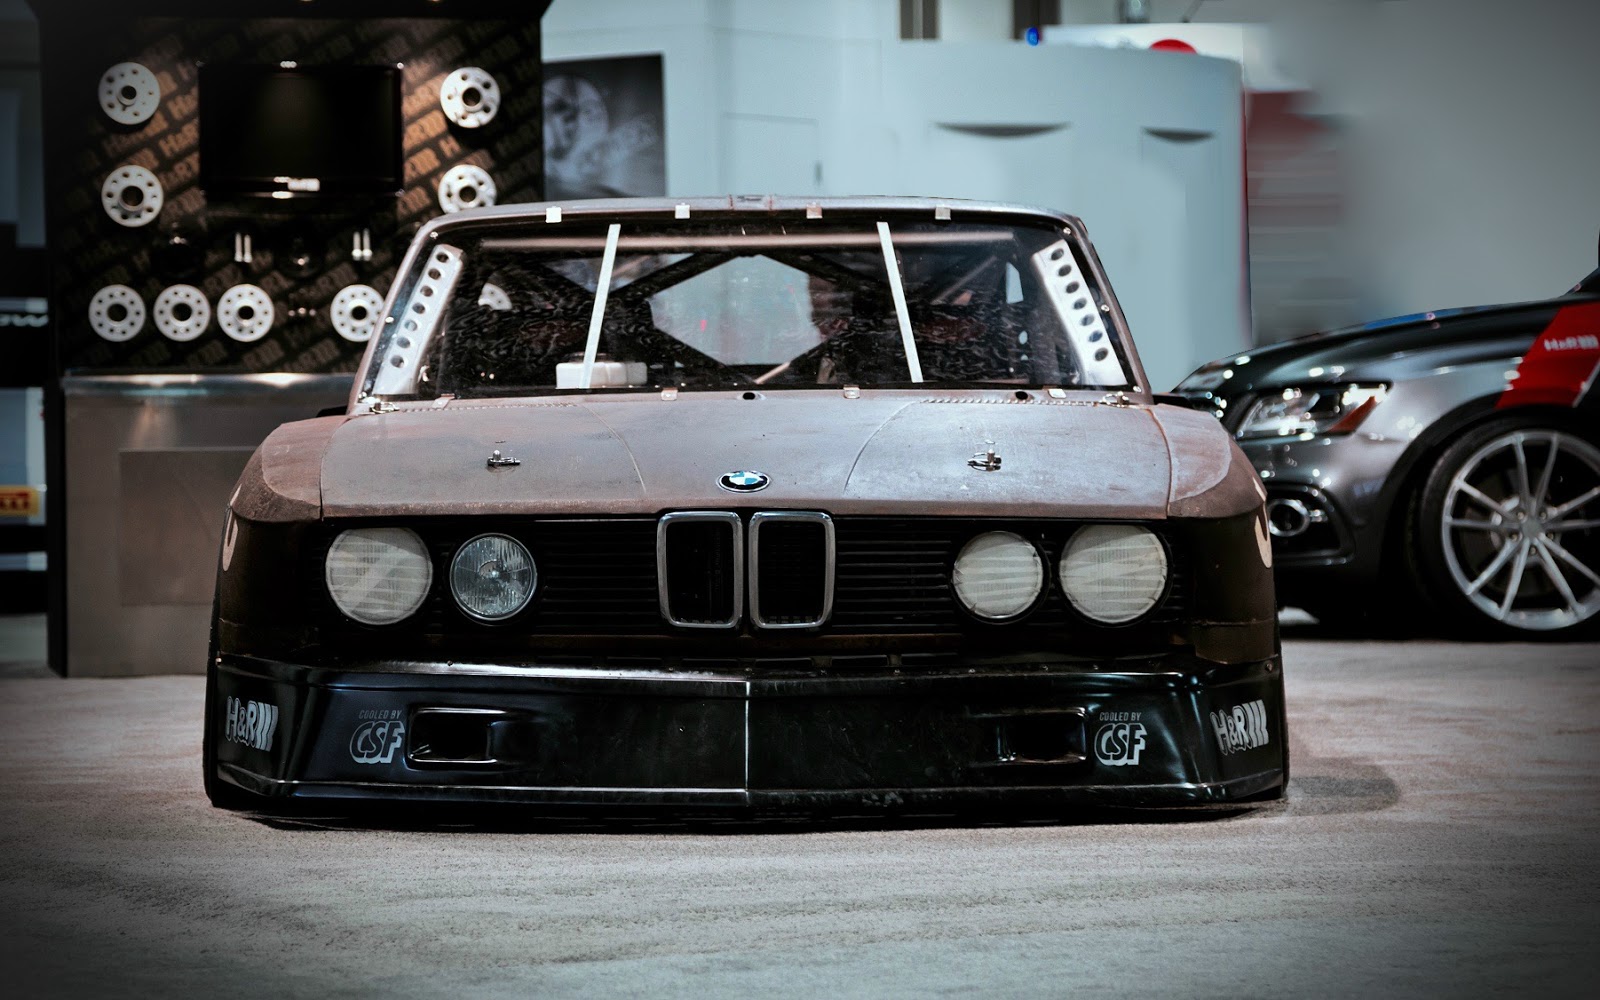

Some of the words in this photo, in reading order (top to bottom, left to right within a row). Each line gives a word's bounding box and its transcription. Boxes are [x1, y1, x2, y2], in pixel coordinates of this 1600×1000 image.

[358, 709, 389, 720] COOLED
[390, 709, 403, 720] BY
[1099, 711, 1130, 721] COOLED
[1130, 711, 1142, 721] BY
[349, 720, 406, 764] CSF
[1094, 722, 1148, 766] CSF
